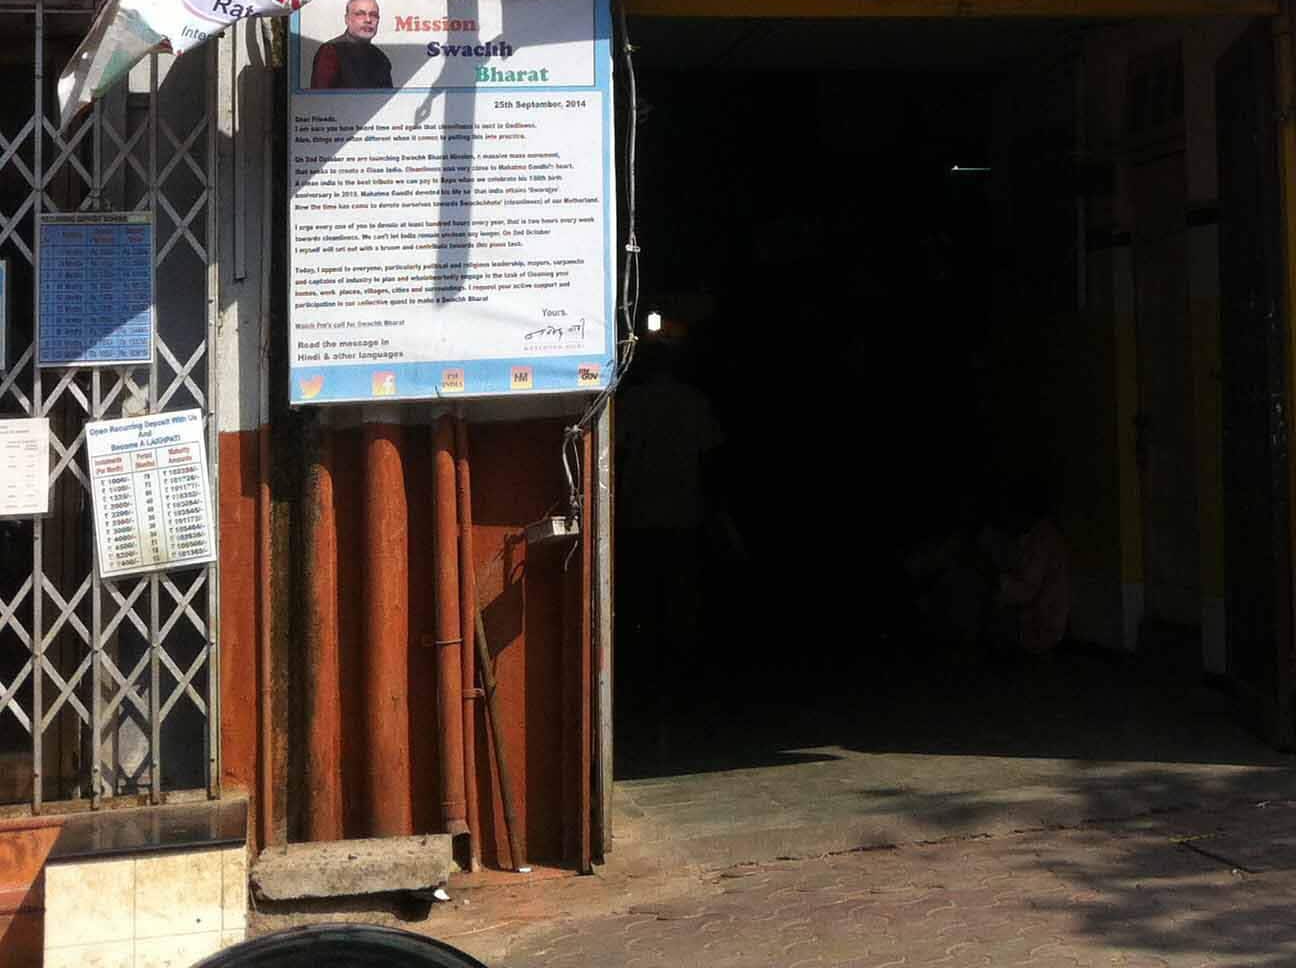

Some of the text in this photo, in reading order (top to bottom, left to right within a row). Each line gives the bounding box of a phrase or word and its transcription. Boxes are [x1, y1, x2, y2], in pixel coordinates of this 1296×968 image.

[394, 15, 479, 32] Mission
[426, 41, 513, 58] Swachh
[475, 65, 550, 83] Bharat
[494, 99, 587, 110] 25th September, 2014
[297, 338, 389, 349] Read the message in
[297, 353, 320, 361] Hindi
[332, 352, 356, 360] other
[358, 350, 404, 361] languages
[109, 422, 143, 433] Recurring
